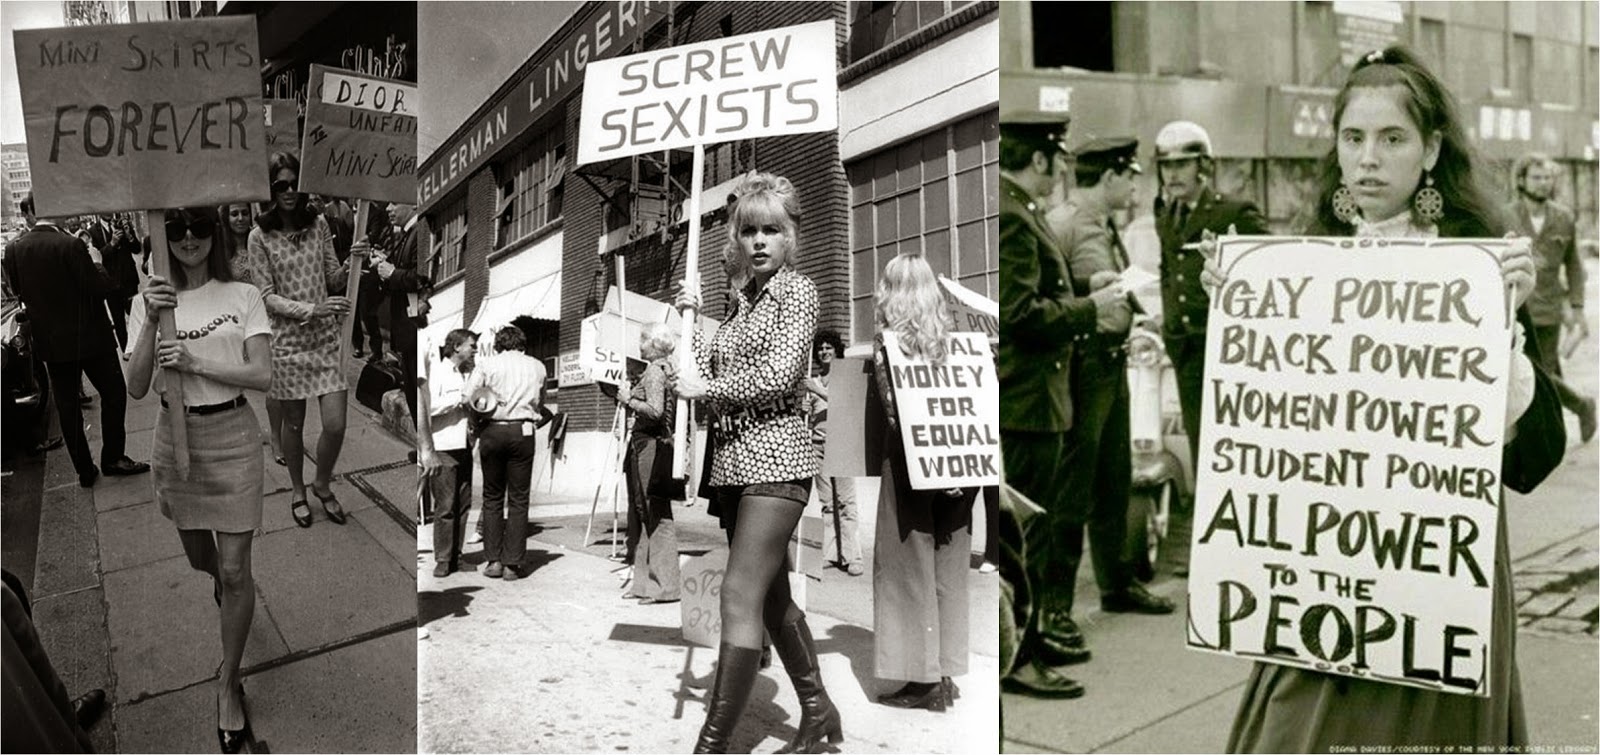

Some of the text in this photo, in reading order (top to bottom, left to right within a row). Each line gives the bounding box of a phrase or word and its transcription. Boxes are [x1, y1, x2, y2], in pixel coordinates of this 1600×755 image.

[618, 34, 792, 96] SCREW
[335, 79, 407, 114] DIOR
[349, 110, 417, 135] UNFAI
[598, 79, 820, 153] SEXISTS
[48, 97, 251, 164] FOREVER
[417, 106, 508, 208] KELLERMAN
[1222, 276, 1483, 328] GAY POWER
[892, 365, 983, 389] MONEY
[1220, 324, 1498, 385] BLACK POWER
[911, 423, 998, 449] EQUAL
[927, 396, 977, 417] FOR
[1212, 379, 1497, 449] WOMEN POWER
[918, 453, 998, 479] WORK
[1212, 438, 1498, 507] STUDENT POWER
[1198, 488, 1490, 588] ALL POWER
[1263, 563, 1377, 601] TO THE
[1217, 580, 1479, 691] PEOPLE
